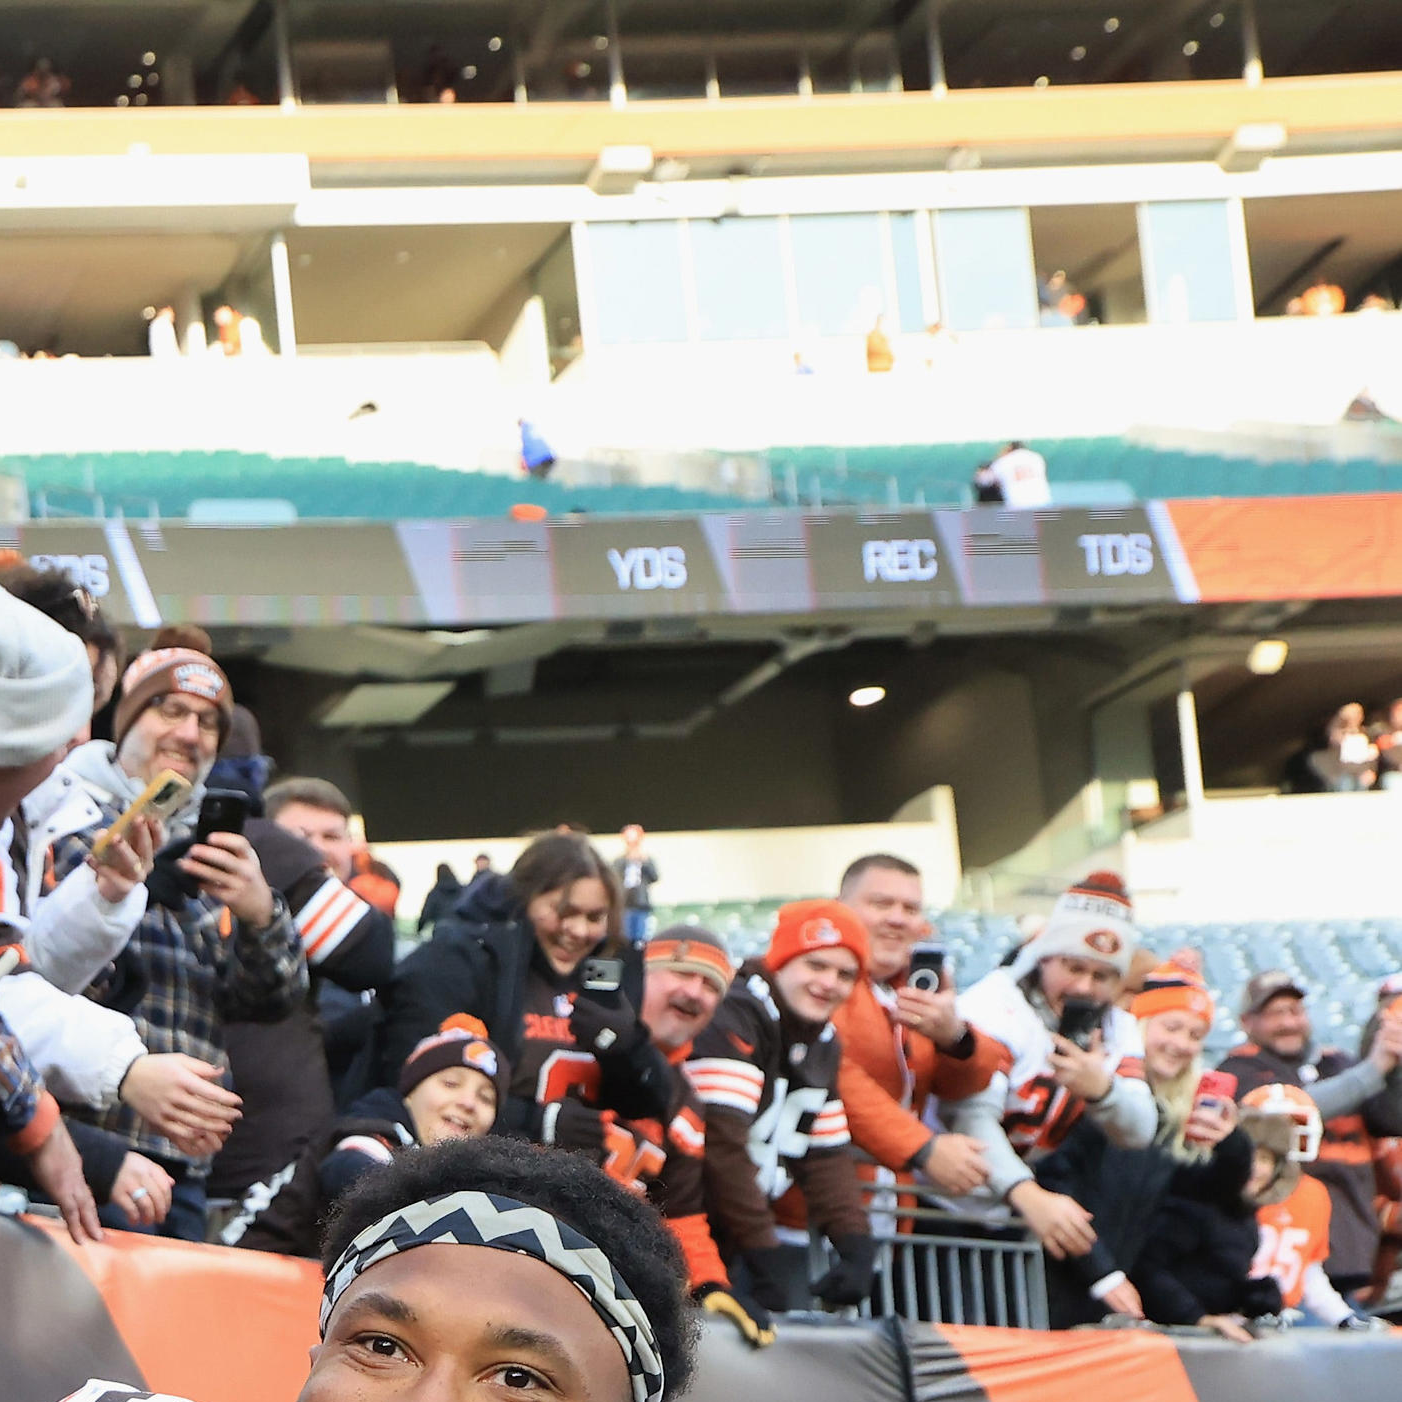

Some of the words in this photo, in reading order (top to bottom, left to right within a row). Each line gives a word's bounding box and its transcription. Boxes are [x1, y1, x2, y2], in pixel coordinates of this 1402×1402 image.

[607, 546, 688, 590] YDS
[862, 539, 938, 583] REC
[1078, 533, 1154, 577] TDS
